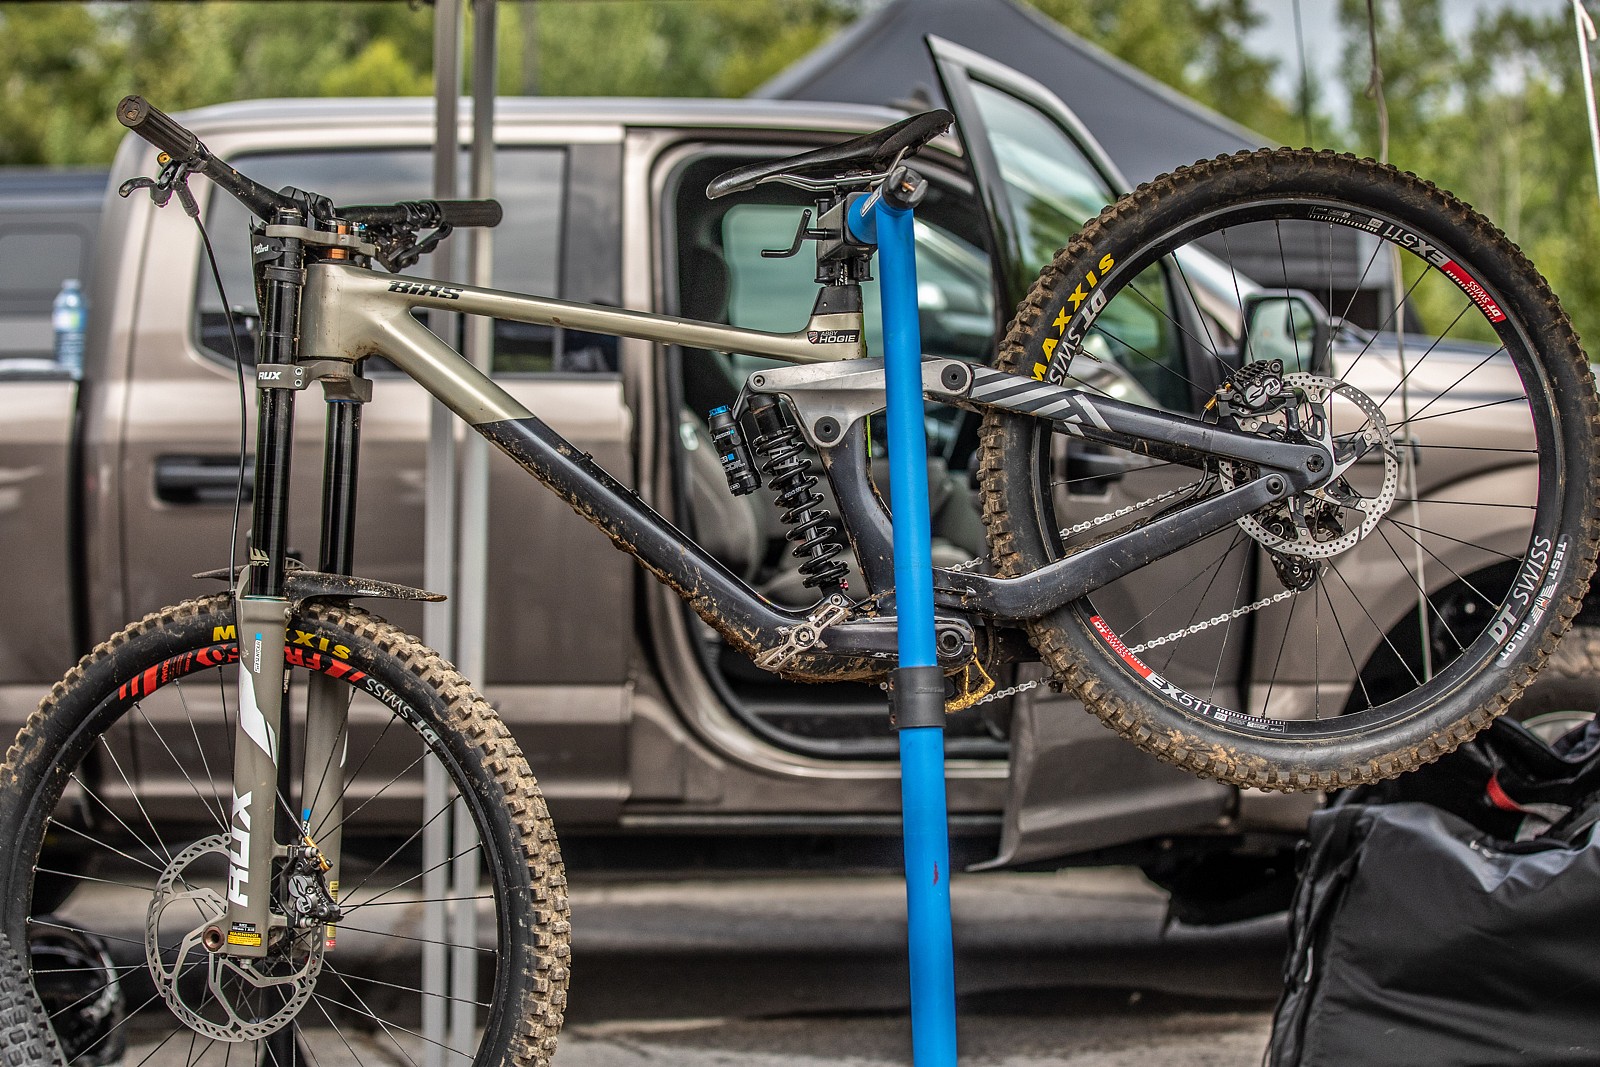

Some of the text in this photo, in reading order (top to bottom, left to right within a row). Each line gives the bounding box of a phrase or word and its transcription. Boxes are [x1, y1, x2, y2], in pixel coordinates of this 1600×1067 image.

[1383, 224, 1450, 268] EX511
[1468, 281, 1502, 318] DT SWISS
[819, 334, 856, 343] HOGIE
[1049, 288, 1107, 386] DT SWIS
[258, 371, 282, 380] RUX
[1487, 535, 1552, 645] DT SWISS
[1500, 541, 1568, 660] TEST PILOT
[1094, 621, 1128, 658] DT SWISS
[366, 678, 440, 746] DT SWISS
[1145, 672, 1211, 716] EX511
[229, 788, 252, 908] RUX
